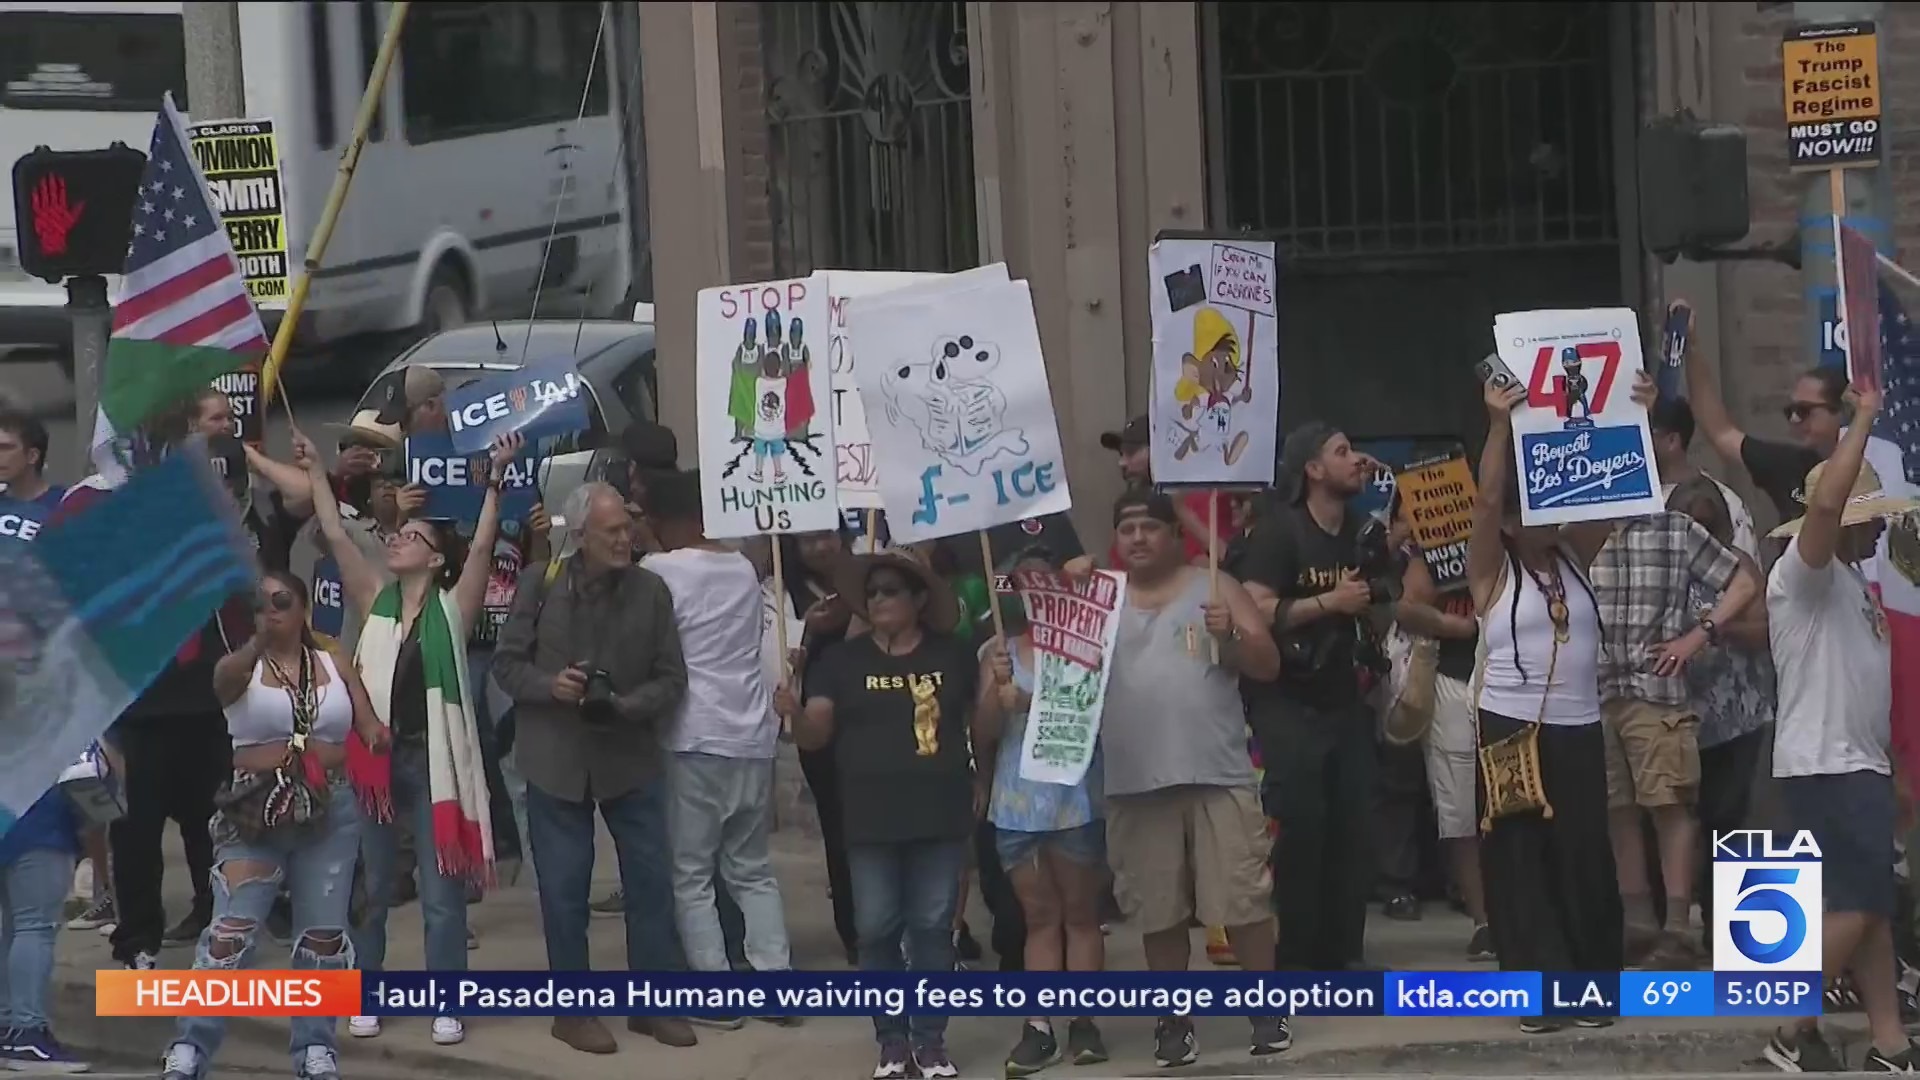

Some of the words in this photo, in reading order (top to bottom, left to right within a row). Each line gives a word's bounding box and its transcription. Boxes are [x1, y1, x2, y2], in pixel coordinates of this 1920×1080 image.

[1814, 41, 1845, 53] The
[1797, 58, 1863, 73] Trump
[1793, 74, 1871, 94] Fascist
[1793, 97, 1873, 116] Regime
[200, 125, 260, 136] CLARITA
[1791, 122, 1844, 138] MUST
[1849, 120, 1878, 134] GO
[194, 137, 274, 171] OMINION
[1797, 137, 1874, 158] NOW!!!
[226, 218, 279, 250] ERRY
[719, 283, 806, 318] STOP
[211, 373, 258, 393] UMP
[1528, 341, 1622, 418] 47
[451, 392, 510, 432] ICE
[1532, 431, 1592, 472] Boycott
[412, 457, 467, 486] ICE
[503, 457, 535, 488] A!
[992, 460, 1056, 505] ICE
[1419, 468, 1445, 482] The
[1529, 467, 1562, 494] Los
[1566, 449, 1645, 490] Doyers
[720, 479, 826, 513] HUNTING
[1412, 481, 1463, 502] Trump
[0, 514, 41, 541] CE
[1417, 519, 1473, 542] Regim
[1425, 541, 1468, 564] MUST
[1436, 557, 1467, 580] NO
[314, 577, 341, 608] ICE
